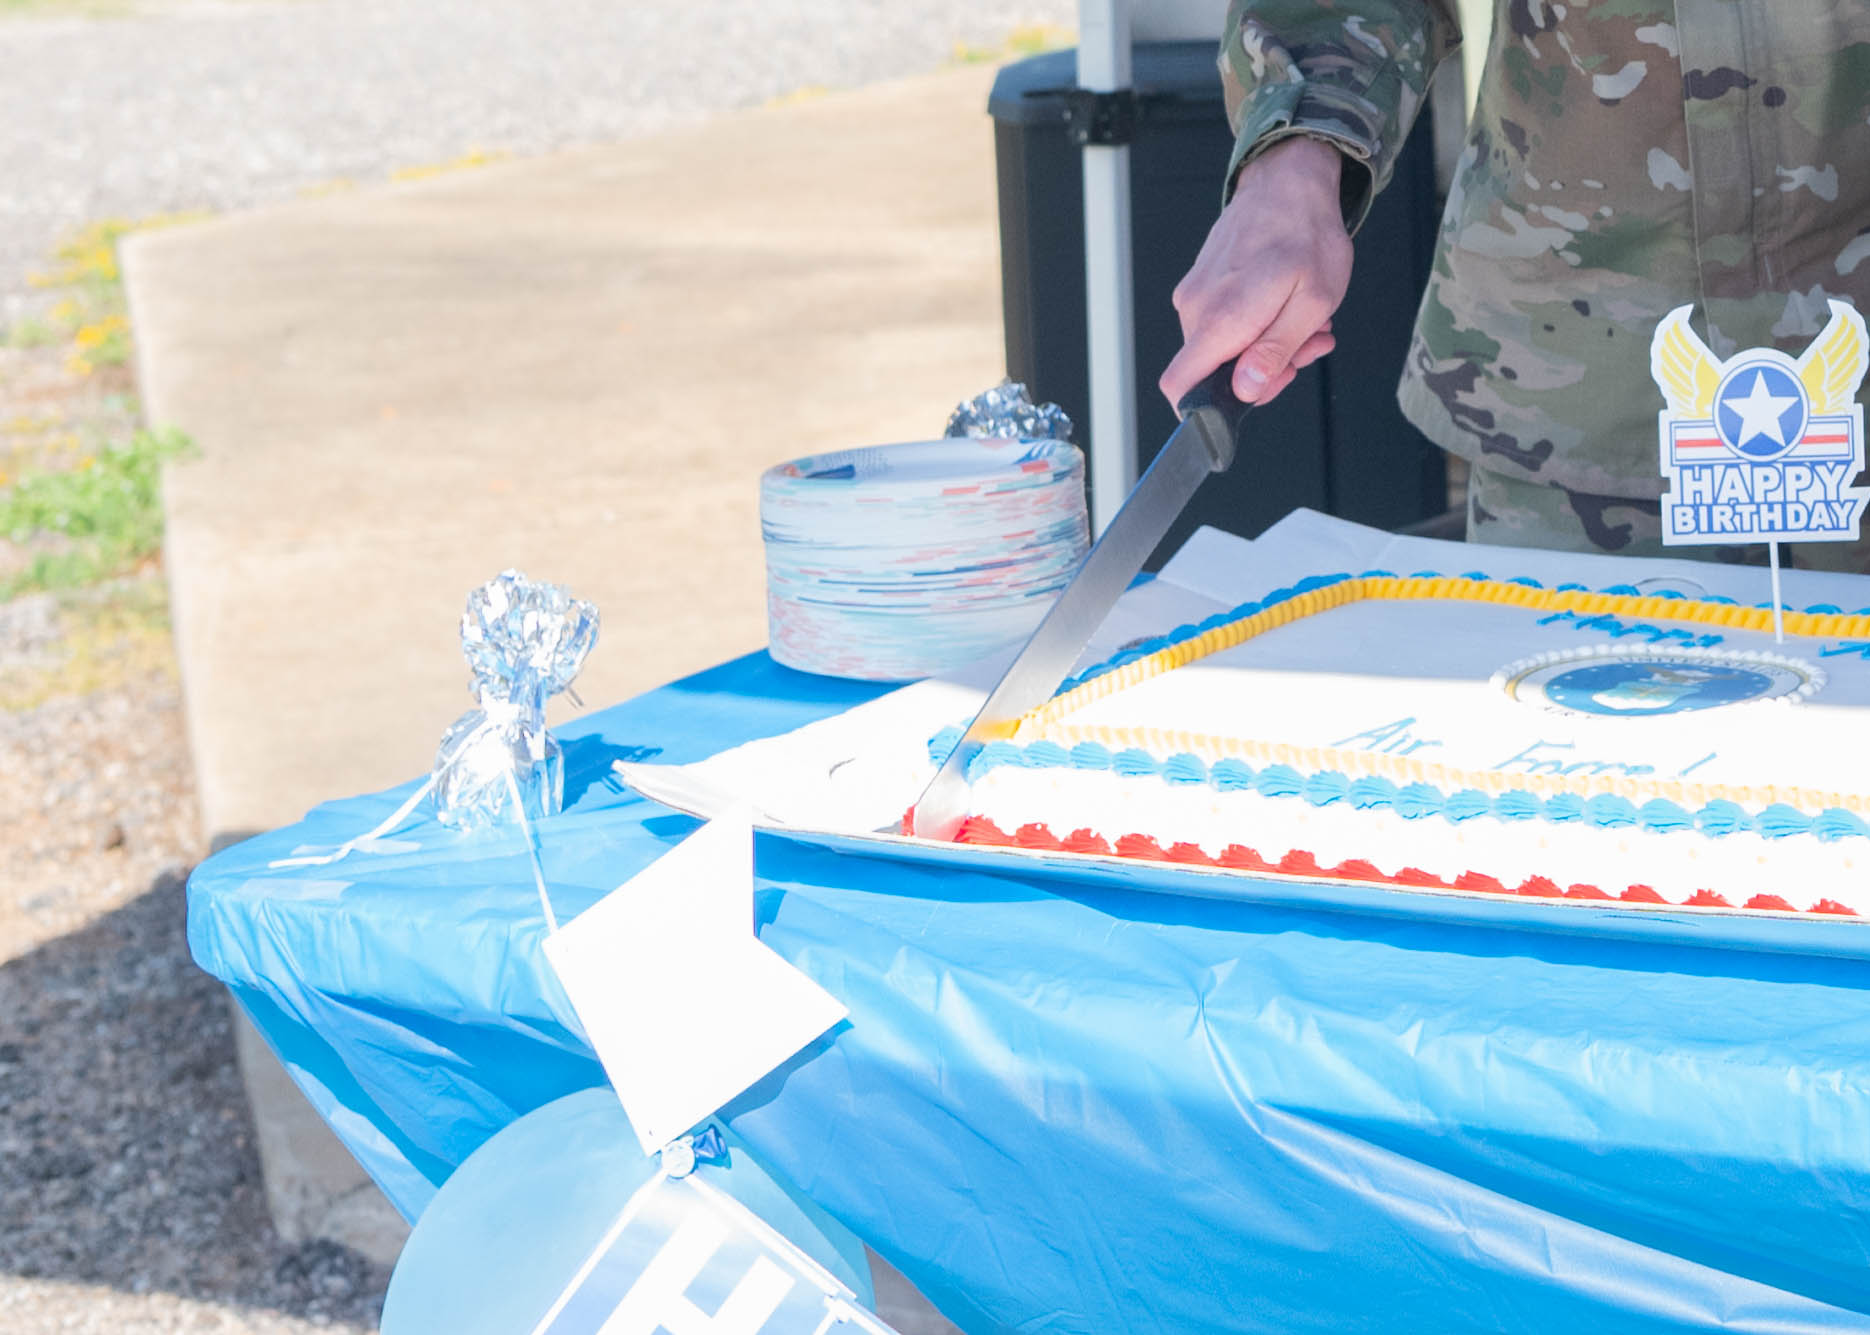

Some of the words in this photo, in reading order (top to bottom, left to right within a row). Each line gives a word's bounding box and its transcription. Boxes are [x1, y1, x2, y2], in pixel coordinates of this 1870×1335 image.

[1680, 463, 1850, 505] HAPPY
[1671, 499, 1858, 535] BIRTHDAY
[1331, 716, 1443, 755] Air
